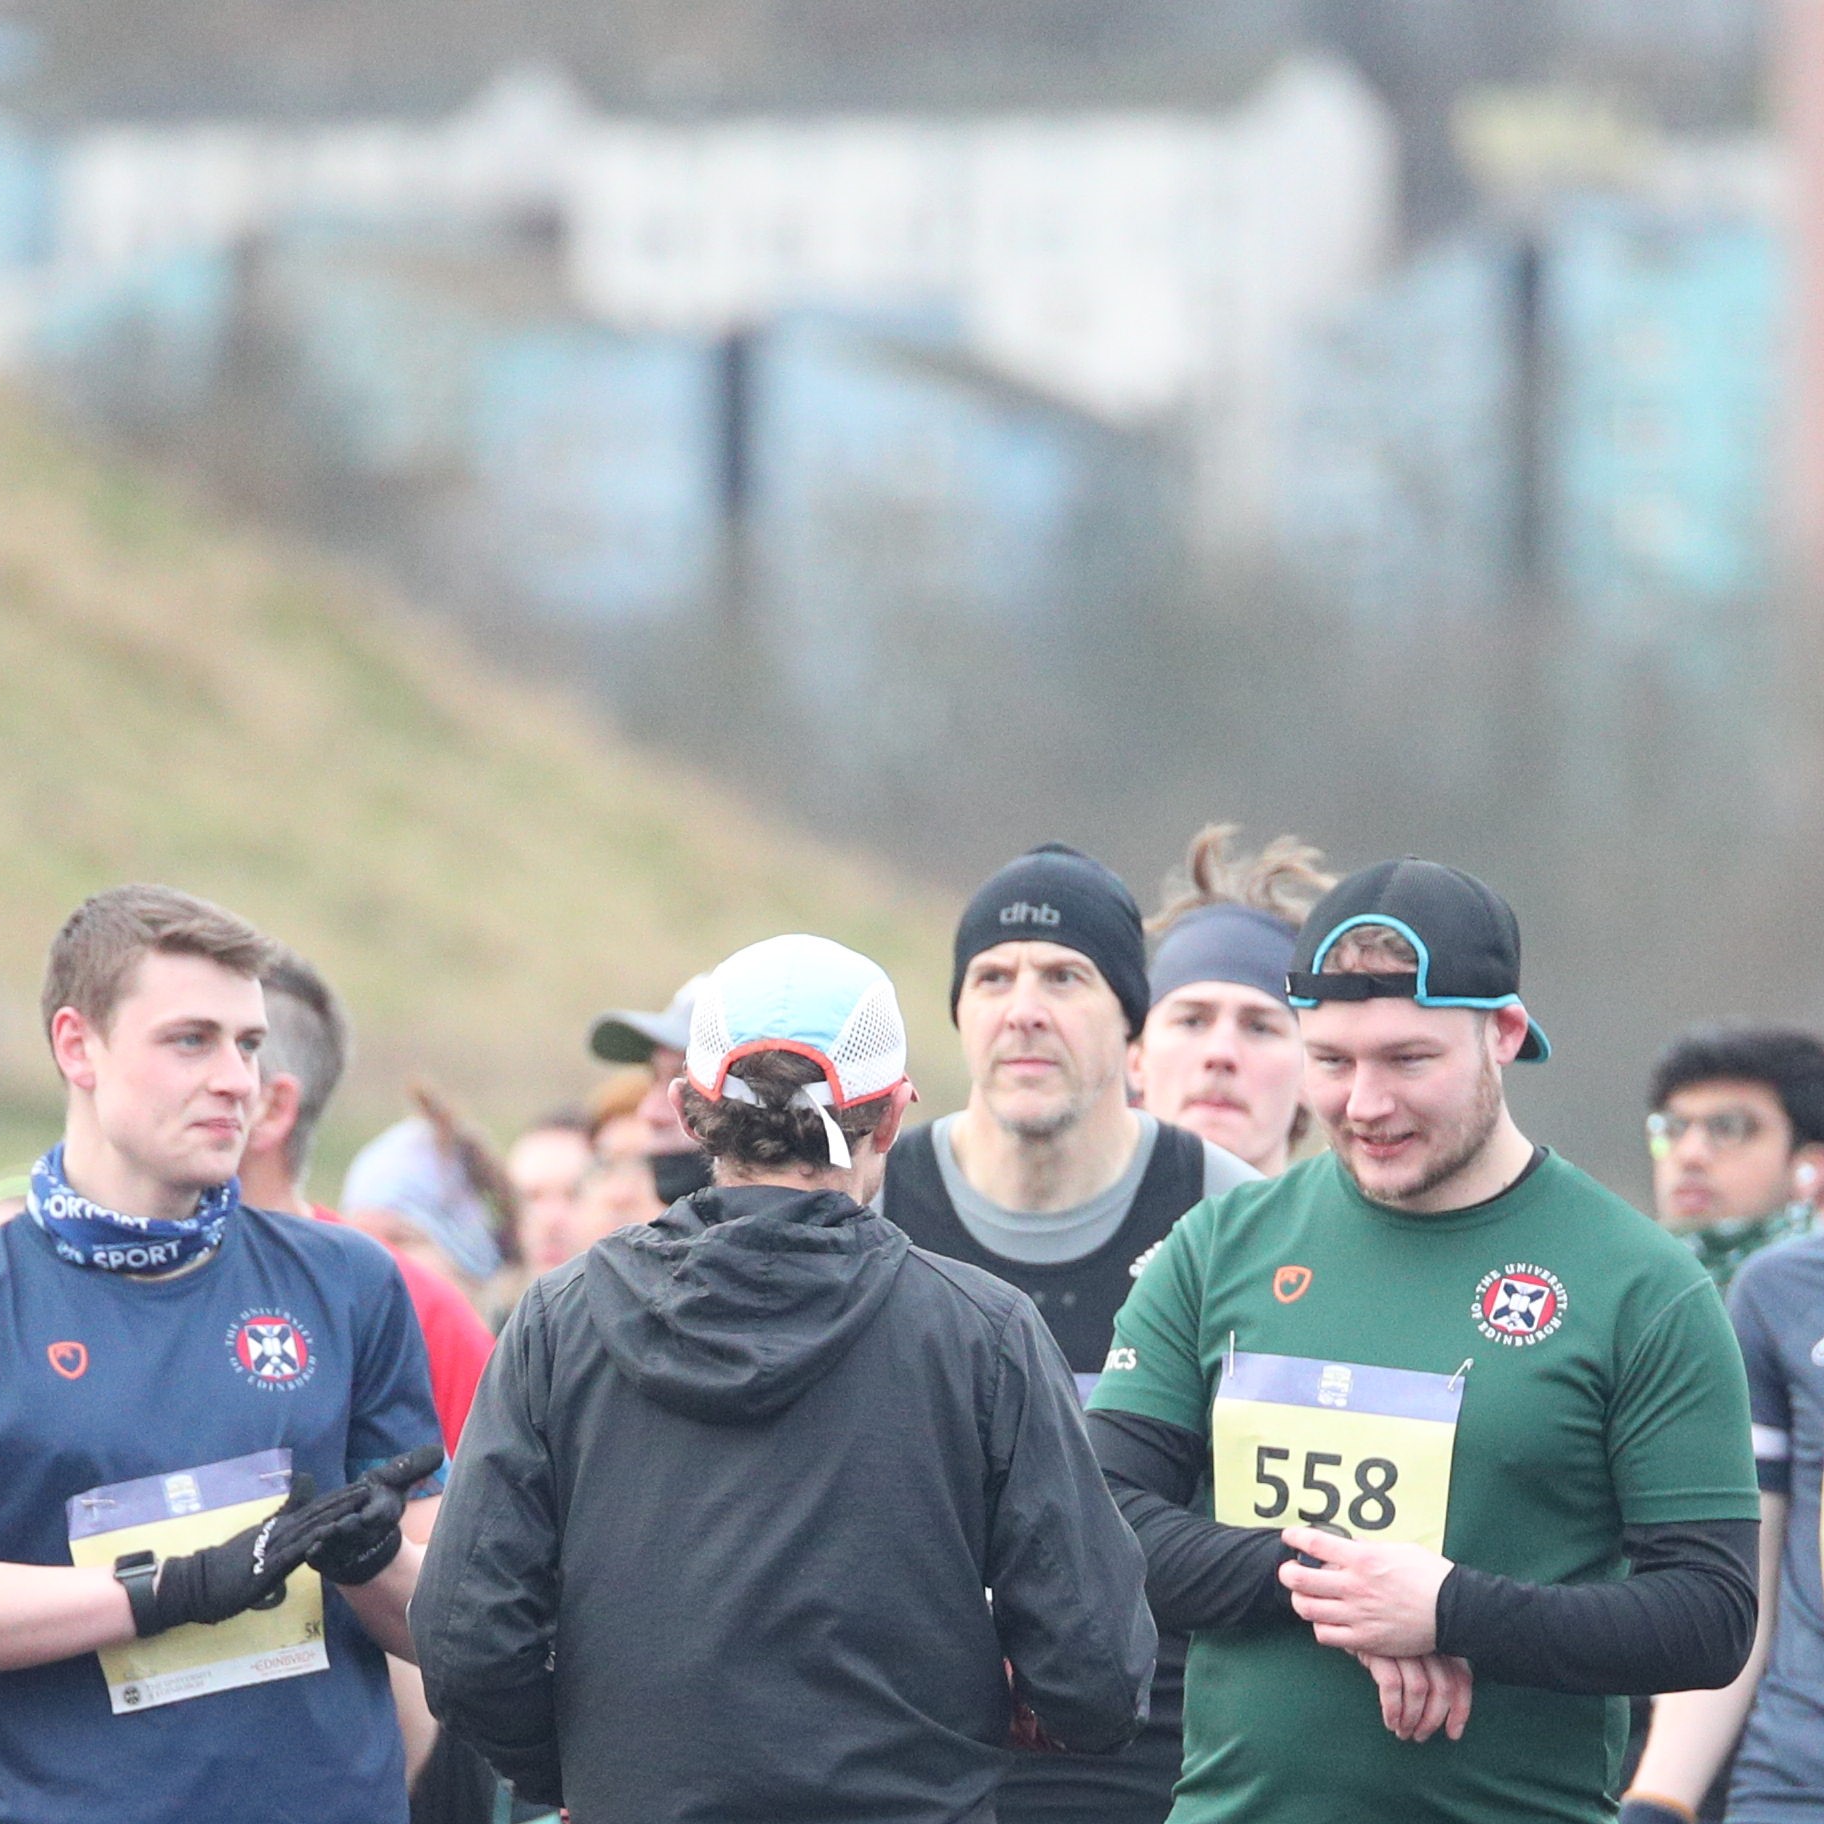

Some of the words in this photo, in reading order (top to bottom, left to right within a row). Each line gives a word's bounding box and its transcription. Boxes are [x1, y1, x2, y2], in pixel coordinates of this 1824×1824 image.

[1000, 902, 1060, 925] dhb
[93, 1240, 181, 1269] SPORT
[1476, 1269, 1501, 1293] THE
[1504, 1262, 1568, 1310] UNIVERSITY
[1470, 1302, 1483, 1319] OF
[1477, 1316, 1562, 1347] EDINBURGH
[1253, 1446, 1399, 1531] 558
[304, 1620, 321, 1639] 5K
